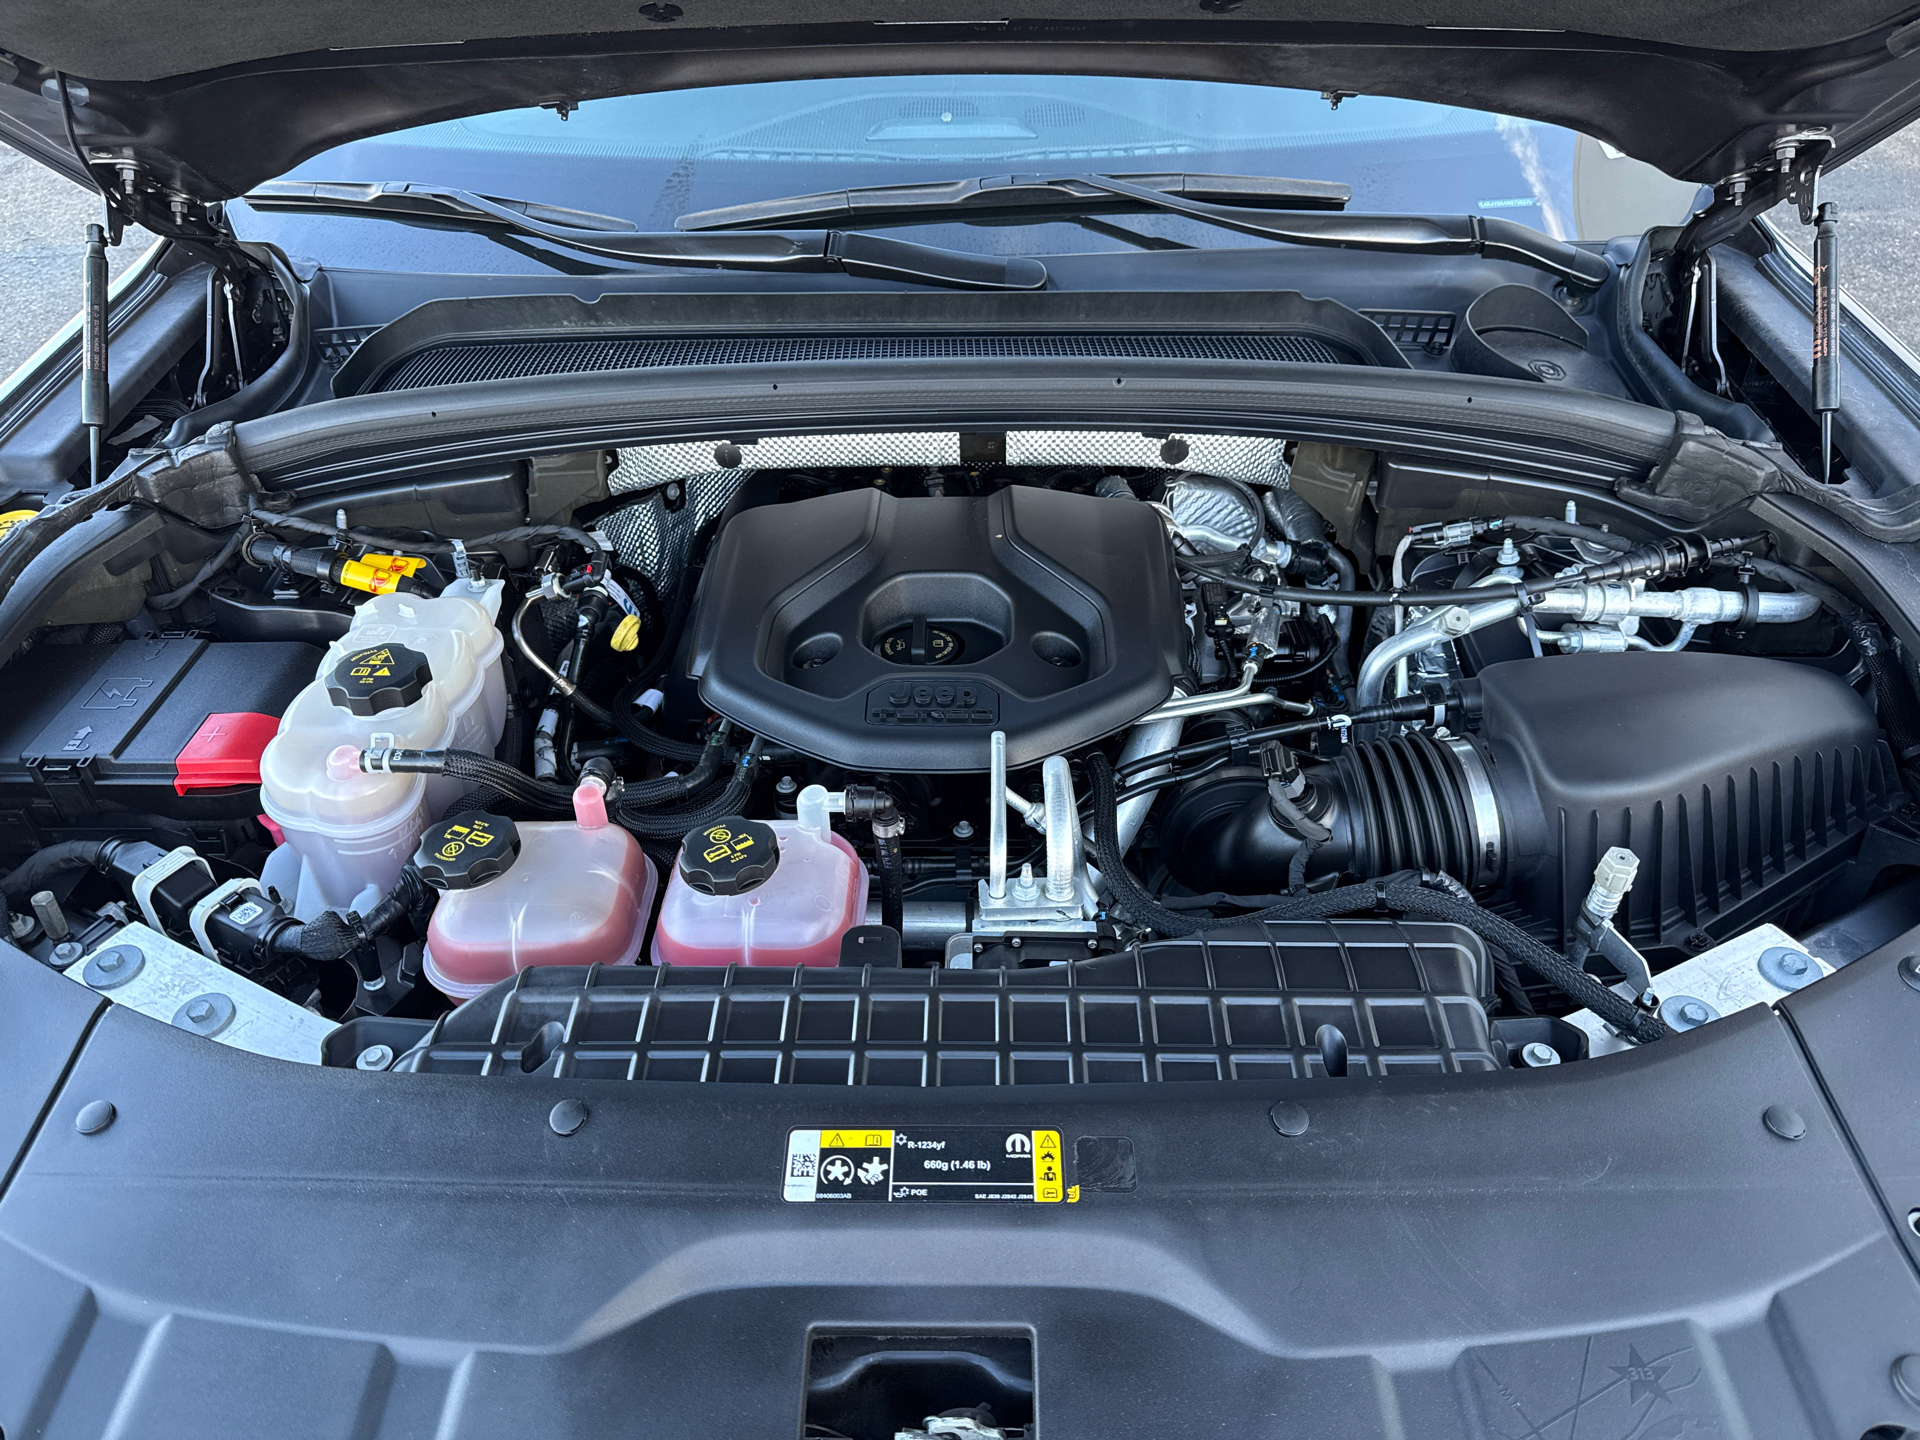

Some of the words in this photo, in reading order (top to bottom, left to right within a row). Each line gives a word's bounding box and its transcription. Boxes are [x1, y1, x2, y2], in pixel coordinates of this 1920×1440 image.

[889, 682, 977, 707] Jeep
[872, 708, 993, 720] TURBO
[907, 1141, 945, 1150] R-1234yf
[924, 1160, 948, 1171] 660g
[950, 1160, 975, 1171] (1.46
[977, 1160, 991, 1171] lb)
[1628, 1367, 1655, 1381] 313
